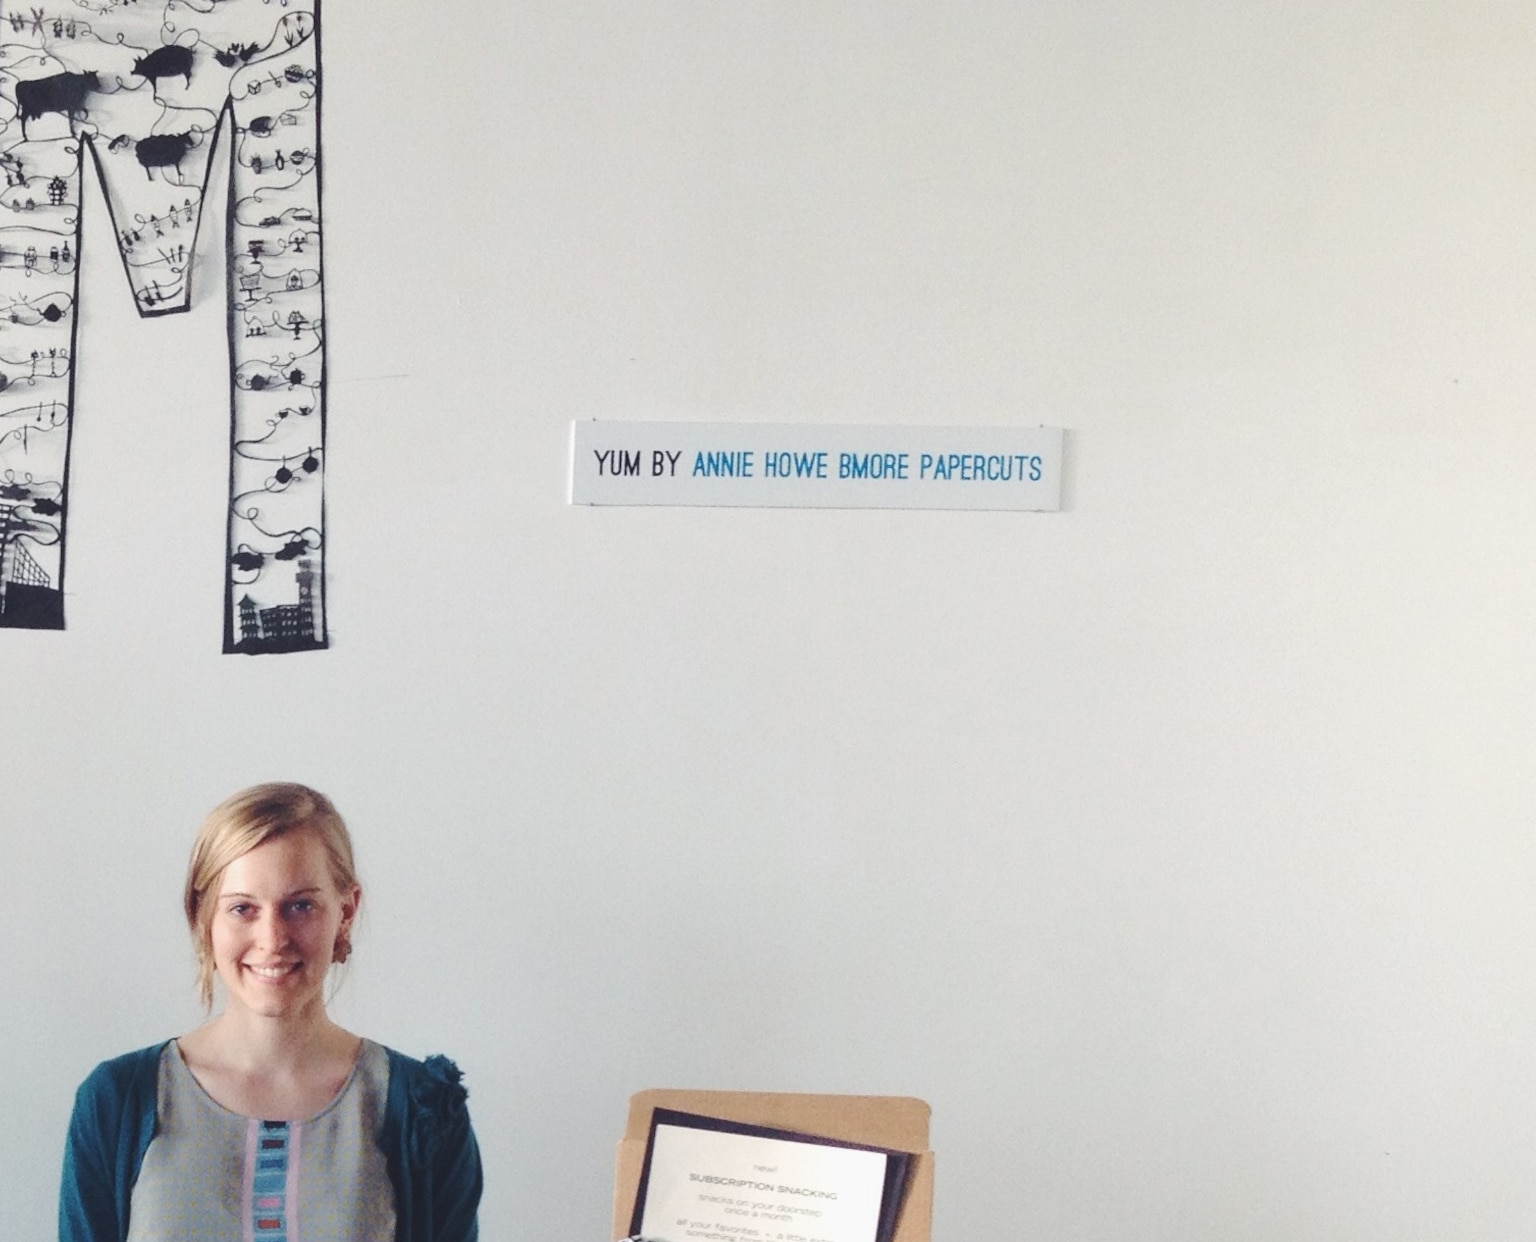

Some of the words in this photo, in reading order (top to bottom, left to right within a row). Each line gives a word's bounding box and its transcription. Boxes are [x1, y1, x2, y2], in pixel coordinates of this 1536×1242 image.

[594, 450, 641, 477] YUM
[652, 451, 682, 477] BY
[693, 451, 754, 478] ANNIE
[764, 452, 828, 479] HOWE
[839, 453, 909, 480] BMORE
[921, 455, 1043, 482] PAPERCUTS
[689, 1173, 774, 1192] SUBSCRIPTION
[777, 1185, 838, 1200] SNACKING
[724, 1207, 749, 1217] once
[760, 1212, 793, 1221] month
[751, 1202, 774, 1210] your
[777, 1204, 822, 1218] doorstep
[714, 1223, 759, 1236] favorites
